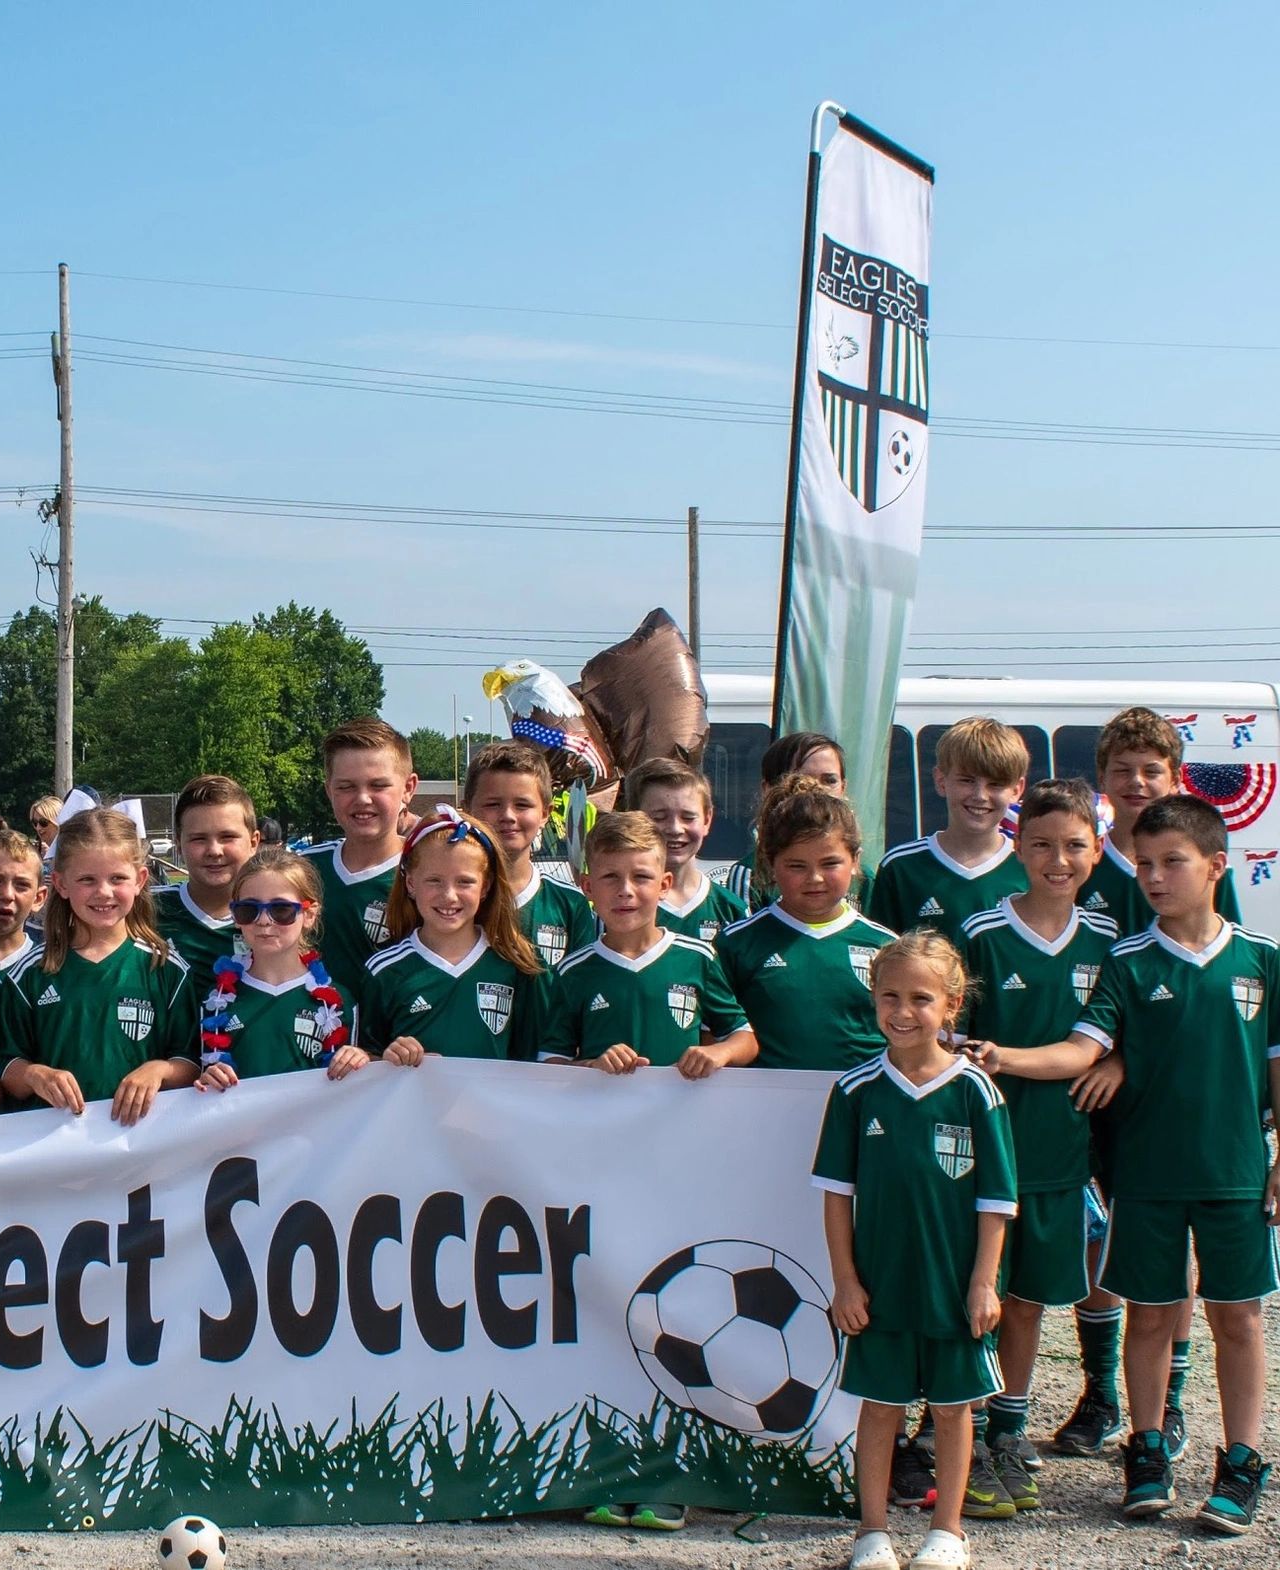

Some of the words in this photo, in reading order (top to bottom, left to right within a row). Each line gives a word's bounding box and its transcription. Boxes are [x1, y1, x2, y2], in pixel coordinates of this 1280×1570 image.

[831, 247, 918, 309] EAGLES
[818, 271, 874, 311] SELECT
[919, 908, 944, 916] adidas
[37, 996, 61, 1006] adidas
[1149, 993, 1174, 1001] adidas
[124, 998, 151, 1006] EAGLES
[410, 1004, 432, 1013] adidas
[199, 1155, 592, 1363] Soccer
